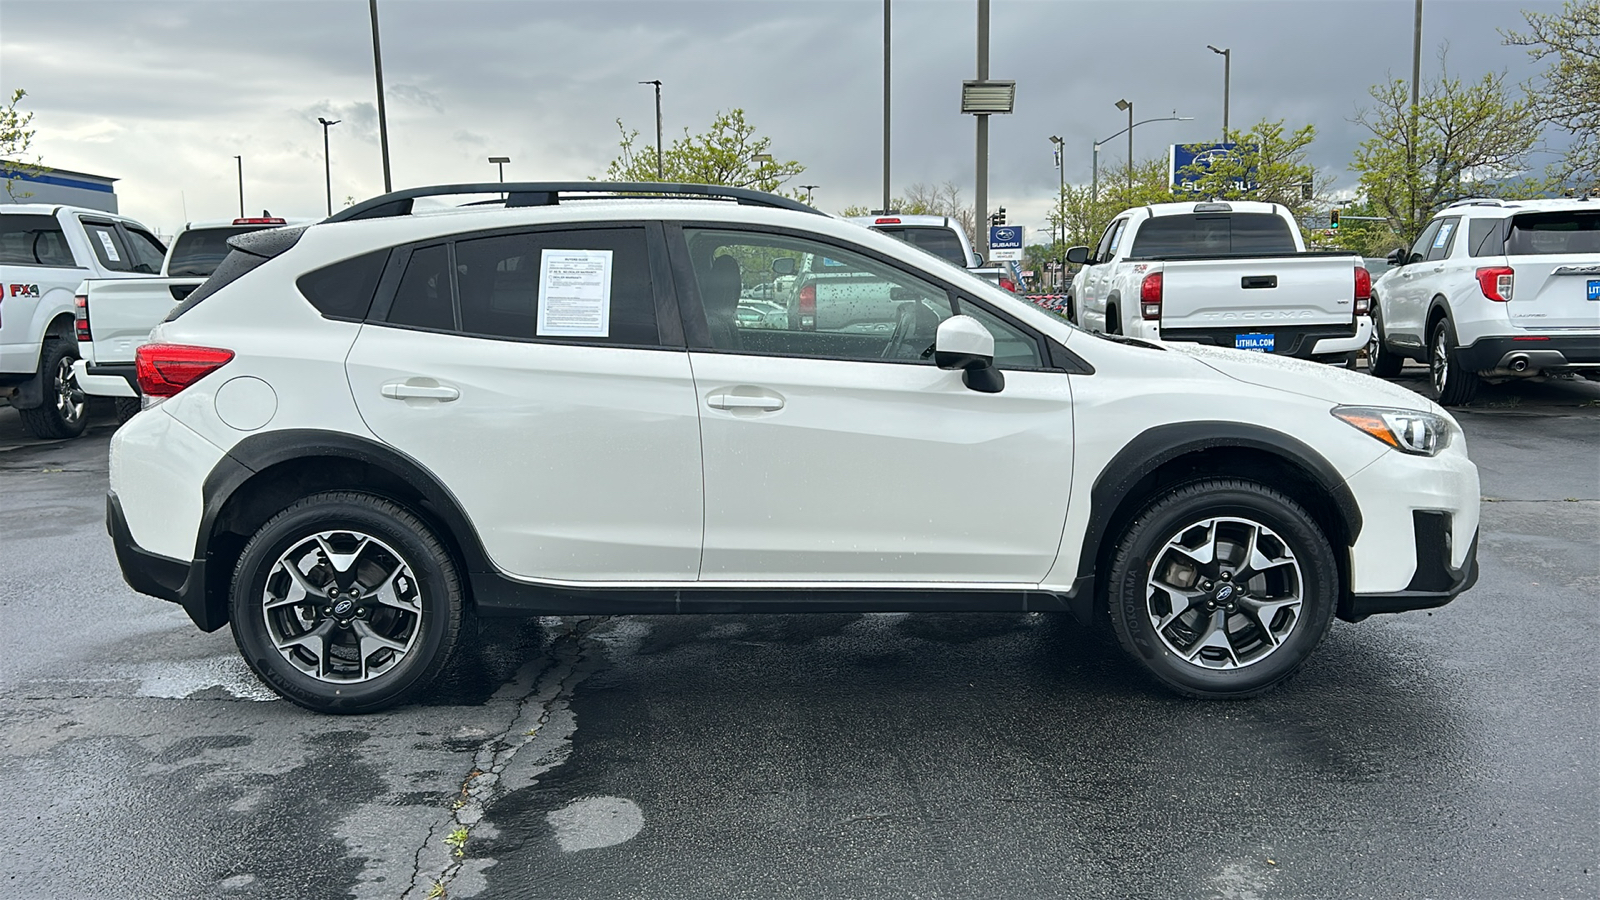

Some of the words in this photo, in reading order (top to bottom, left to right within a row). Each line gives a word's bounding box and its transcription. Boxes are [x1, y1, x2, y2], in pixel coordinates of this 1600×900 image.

[10, 284, 40, 297] FX4
[1203, 311, 1313, 321] TACOMA
[1235, 338, 1275, 348] LITHIA.COM
[1124, 569, 1141, 637] YOKOHAMA
